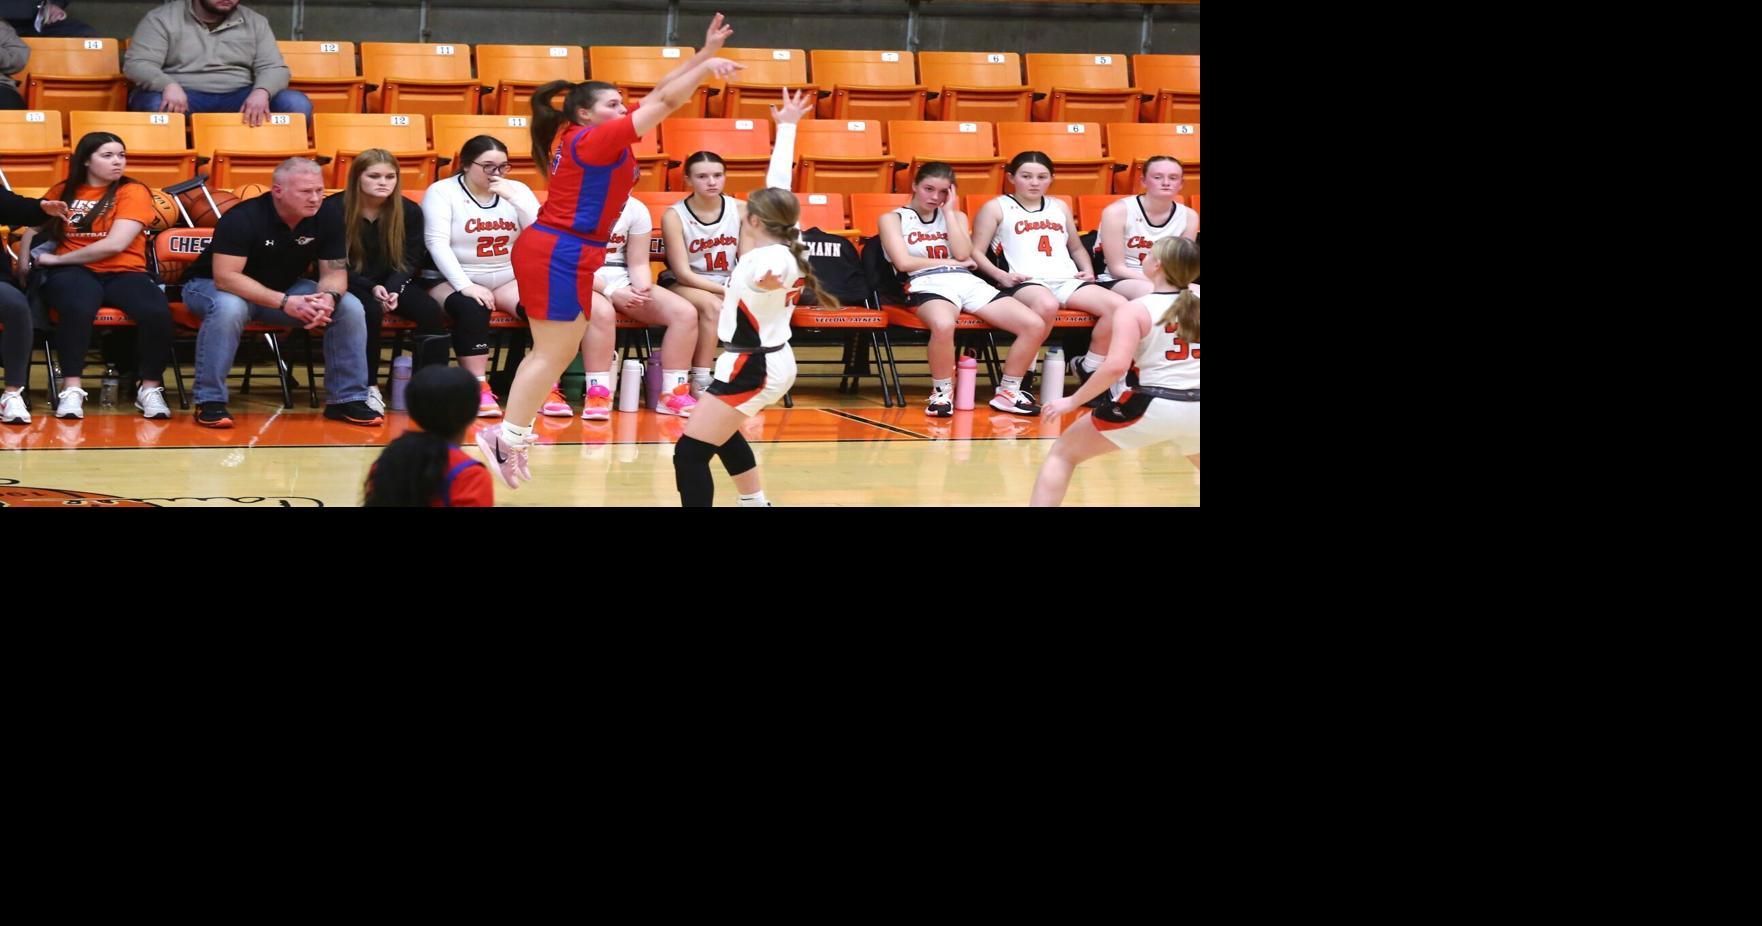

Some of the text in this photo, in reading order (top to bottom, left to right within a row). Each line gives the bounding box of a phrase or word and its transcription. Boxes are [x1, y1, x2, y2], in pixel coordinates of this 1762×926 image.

[87, 40, 99, 49] 14
[323, 43, 336, 52] 12
[439, 46, 451, 54] 11
[993, 55, 999, 63] 6
[1100, 56, 1106, 64] 5
[152, 115, 165, 124] 14
[274, 115, 286, 124] 13
[393, 117, 406, 125] 12
[511, 118, 522, 126] 11
[1072, 125, 1079, 133] 6
[1181, 126, 1188, 134] 5
[465, 218, 517, 234] Chester
[1014, 219, 1064, 235] Chester
[689, 233, 737, 254] Chester
[907, 231, 949, 245] Cheste
[168, 236, 213, 254] CHES
[477, 236, 510, 257] 22
[806, 242, 841, 257] MANN
[1038, 235, 1052, 257] 4
[926, 245, 949, 259] 10
[704, 251, 729, 272] 14
[1164, 322, 1200, 361] 3
